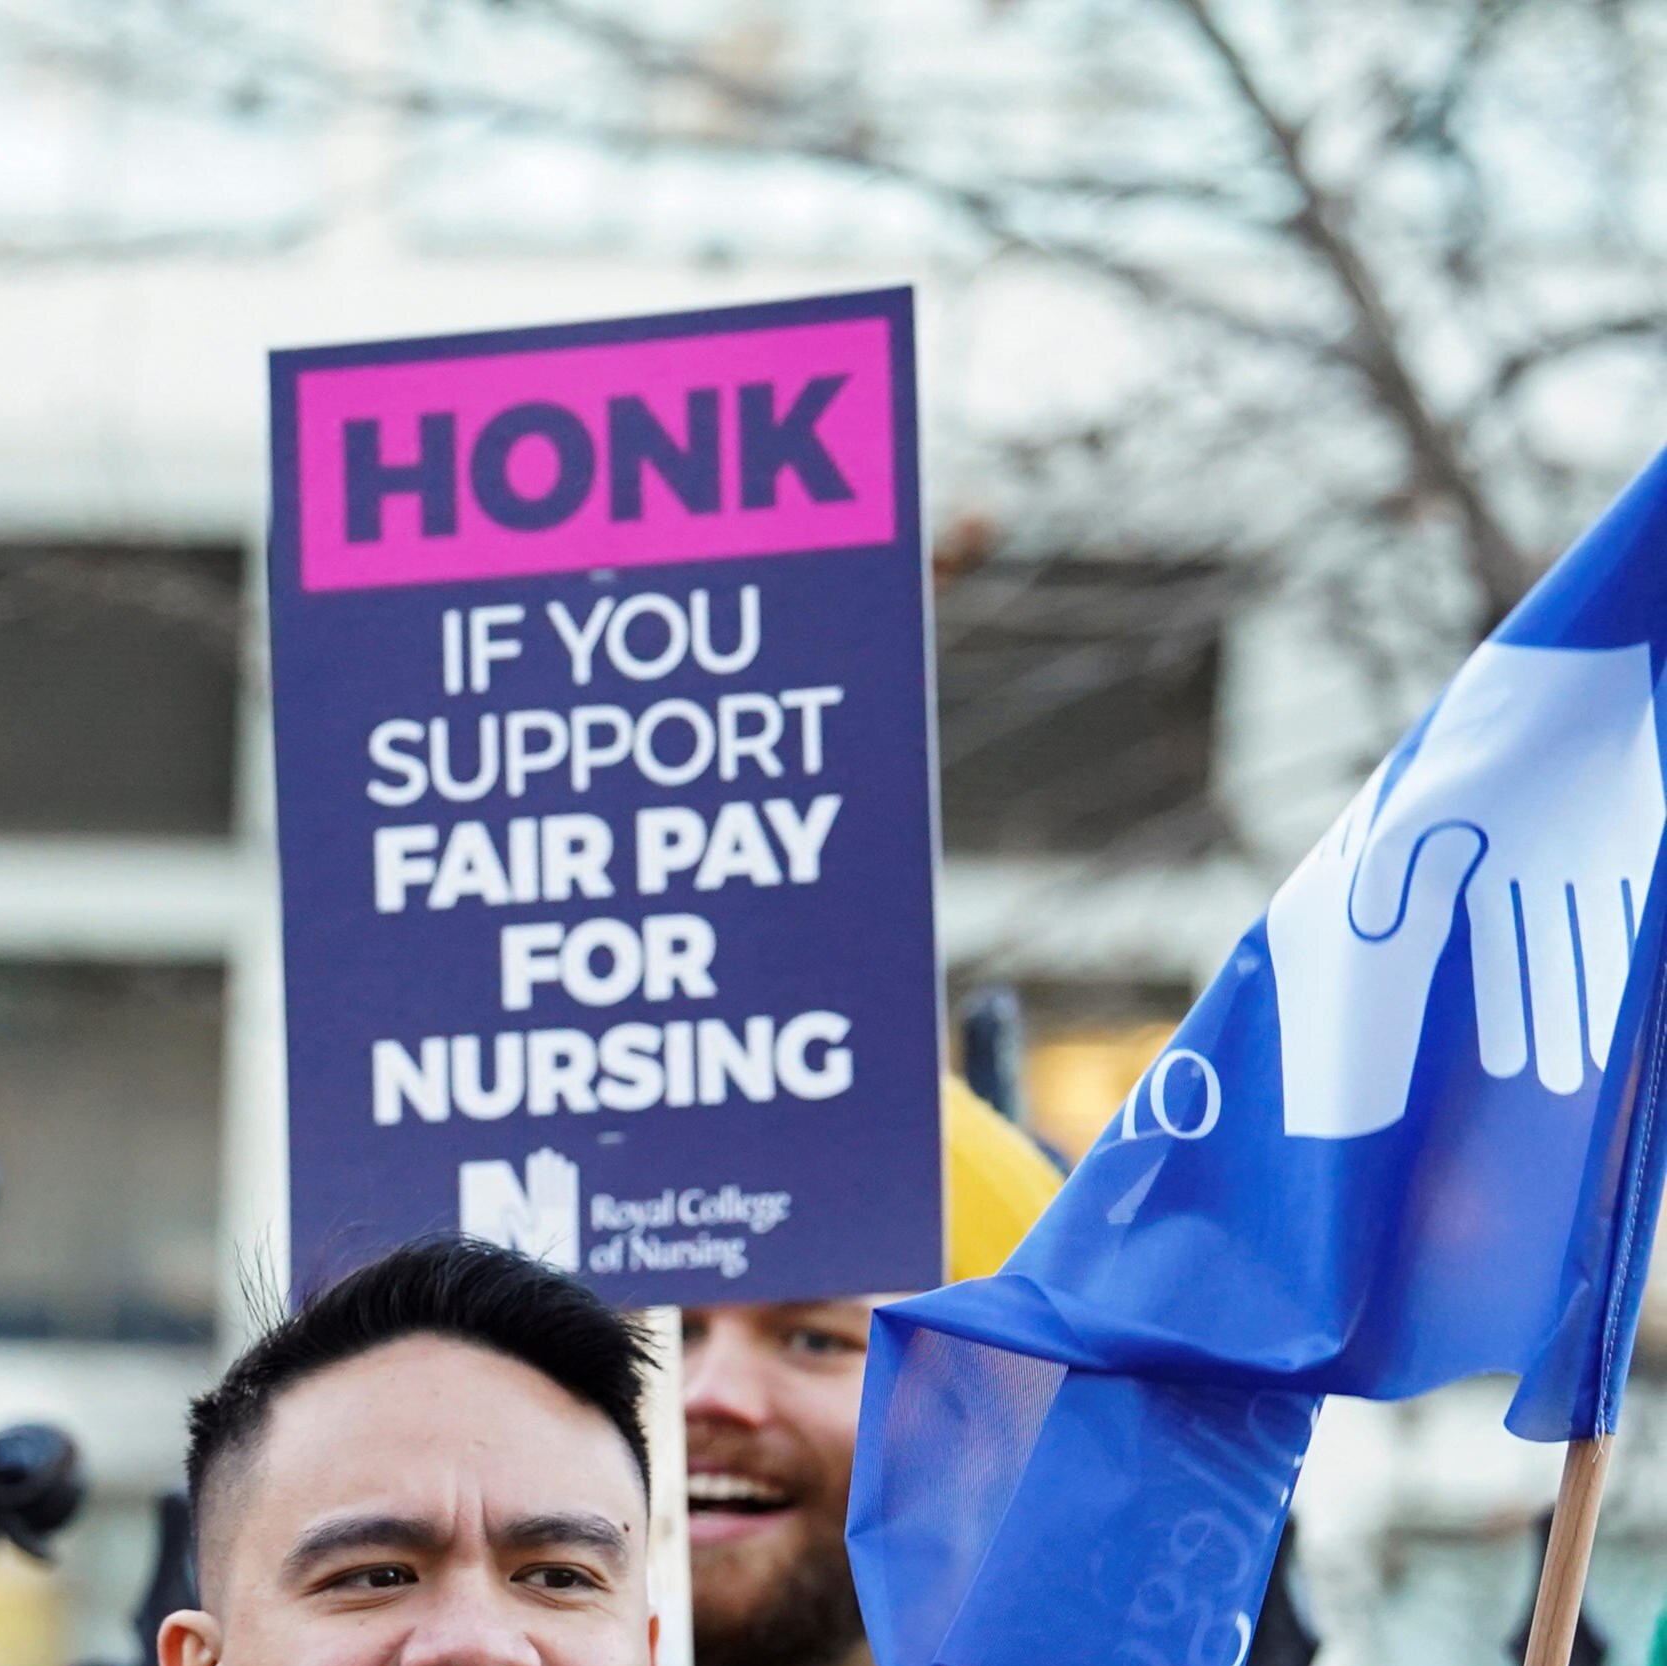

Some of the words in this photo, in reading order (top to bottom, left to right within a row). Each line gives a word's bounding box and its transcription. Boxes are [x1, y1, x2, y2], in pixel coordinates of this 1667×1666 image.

[342, 371, 857, 543] HONK
[441, 603, 526, 696] IF
[546, 584, 761, 687] YOU
[366, 685, 845, 806] SUPPORT
[372, 812, 615, 913] FAIR
[635, 794, 844, 896] PAY
[500, 911, 719, 1012] FOR
[371, 1009, 855, 1126] NURSING
[590, 1187, 676, 1238] Royal
[677, 1184, 792, 1234] College
[628, 1230, 750, 1280] Nursing
